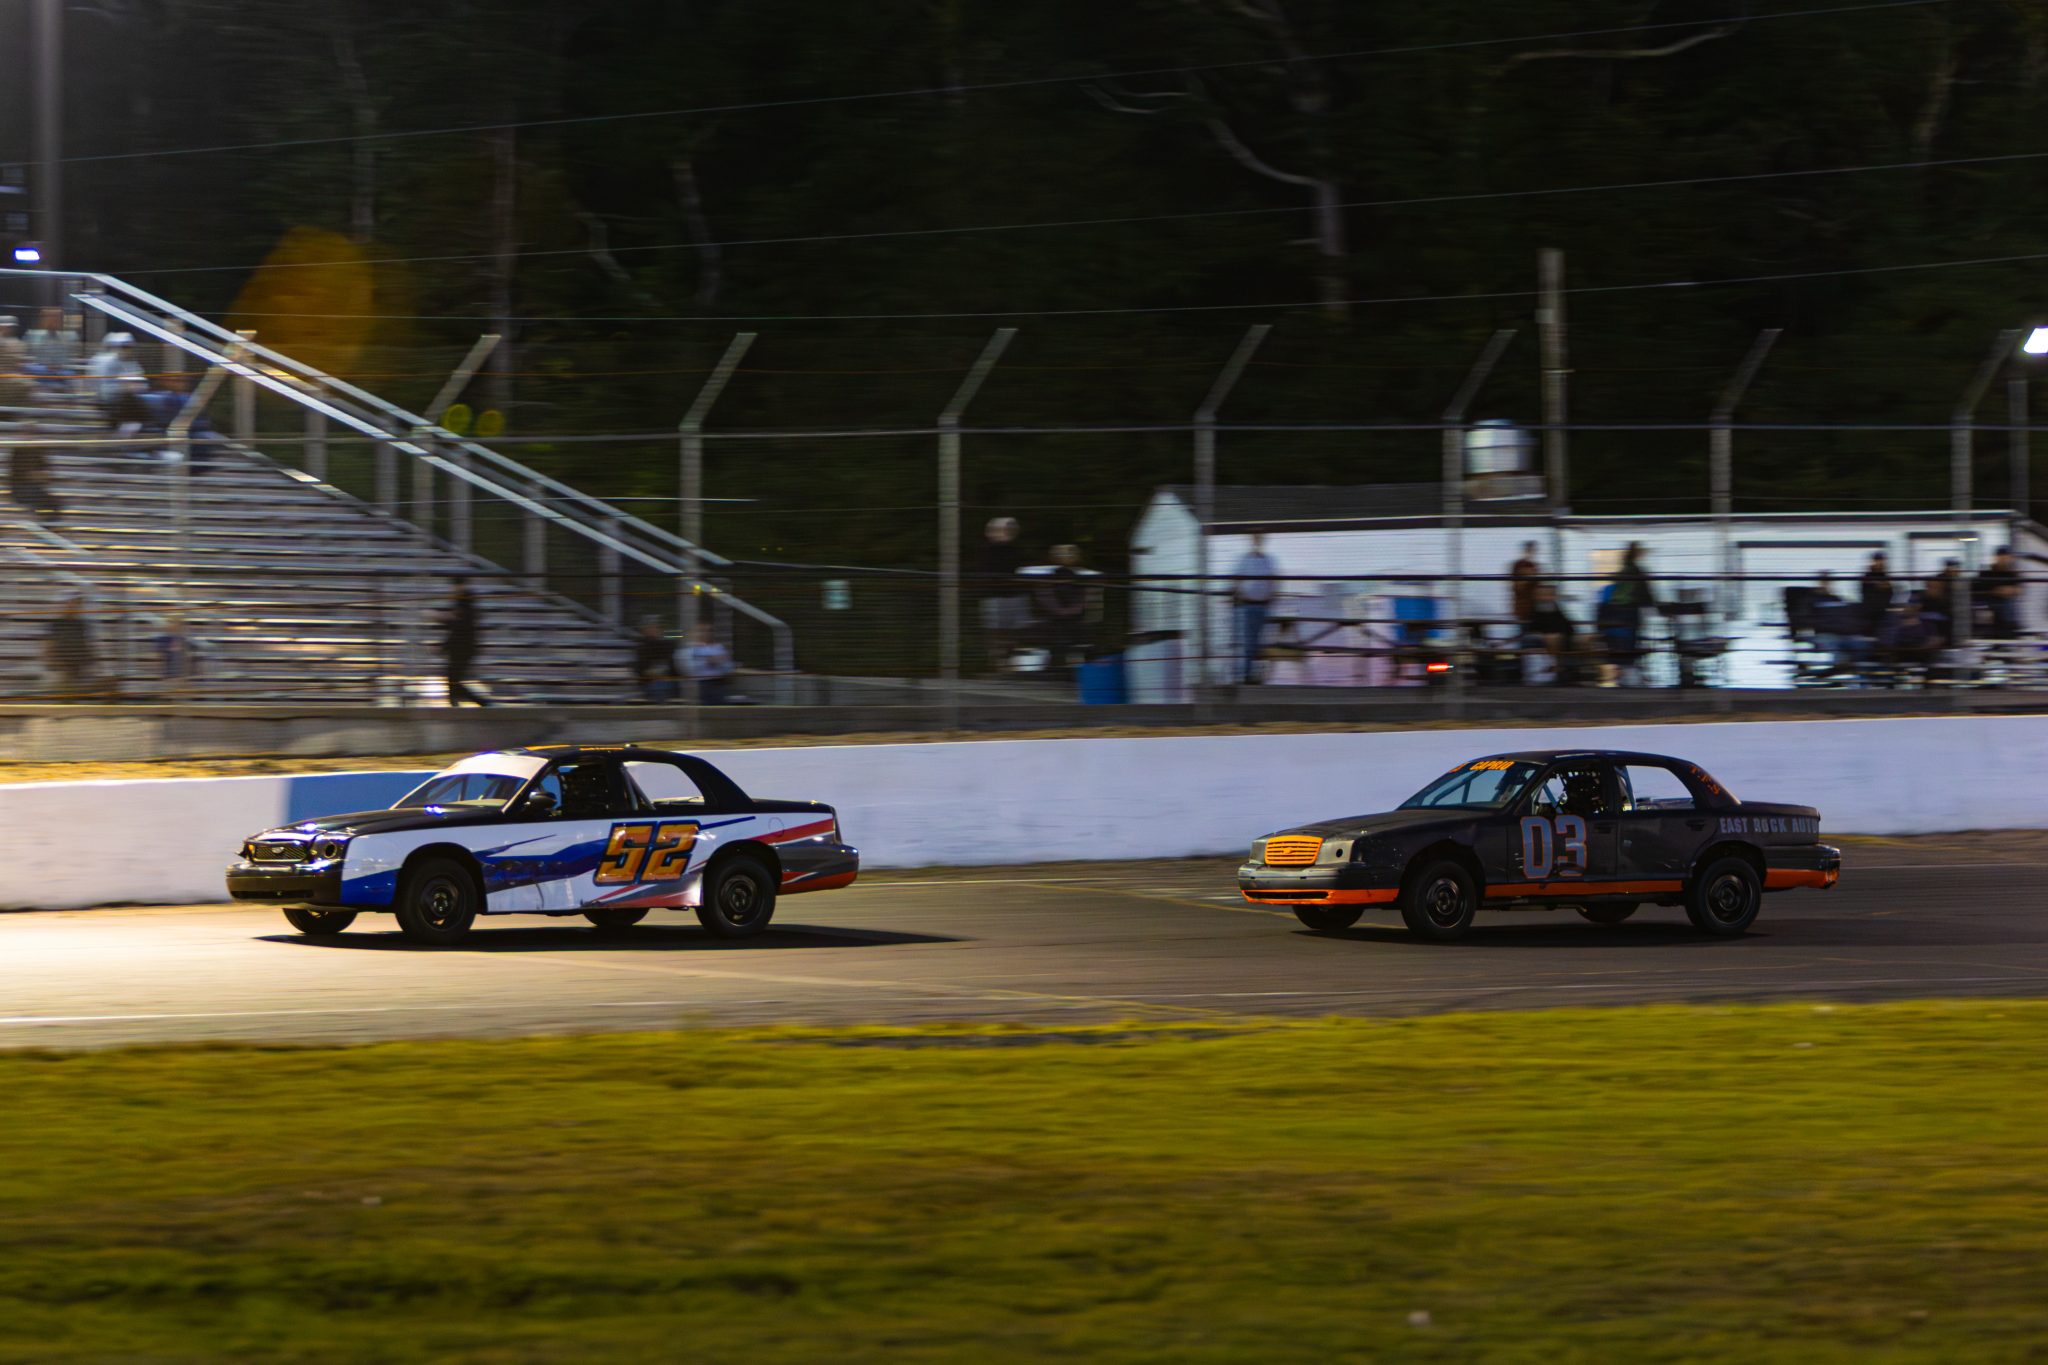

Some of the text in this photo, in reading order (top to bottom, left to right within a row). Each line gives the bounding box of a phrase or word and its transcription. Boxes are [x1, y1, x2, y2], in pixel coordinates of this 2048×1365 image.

[594, 821, 700, 885] 52
[1520, 815, 1588, 879] 03
[1719, 816, 1748, 833] EAST
[1753, 816, 1787, 833] ROCK
